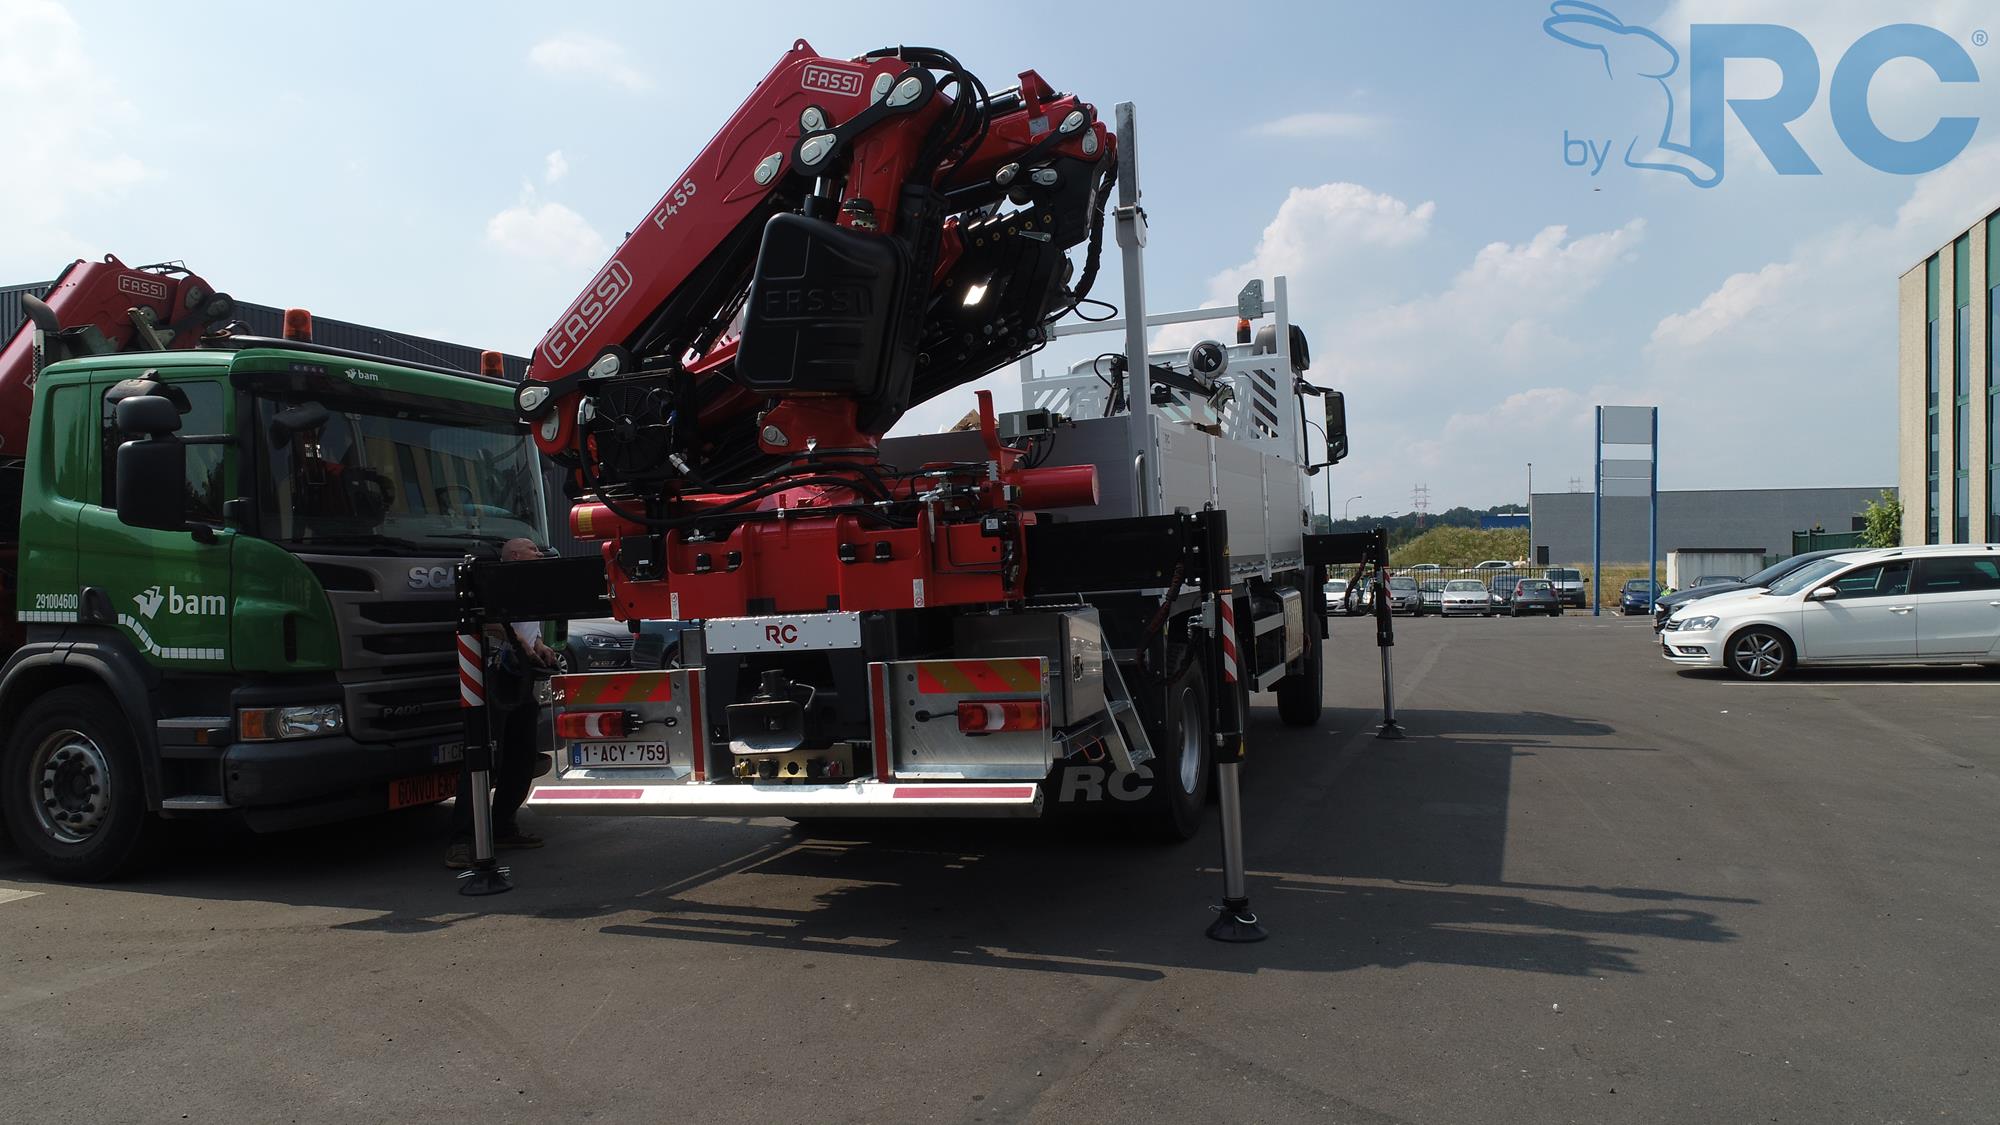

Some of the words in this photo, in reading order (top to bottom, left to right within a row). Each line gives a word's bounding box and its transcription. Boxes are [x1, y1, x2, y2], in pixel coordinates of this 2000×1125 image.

[807, 69, 858, 92] FASSI
[653, 178, 697, 230] F455
[122, 278, 164, 298] FASSI
[765, 289, 864, 314] FASSI
[549, 268, 626, 361] FASSI
[357, 369, 379, 382] bam
[35, 593, 78, 609] 291004600
[168, 585, 226, 616] bam
[765, 624, 798, 644] RC
[583, 744, 666, 762] 1-ACY-759
[1059, 764, 1155, 803] RC
